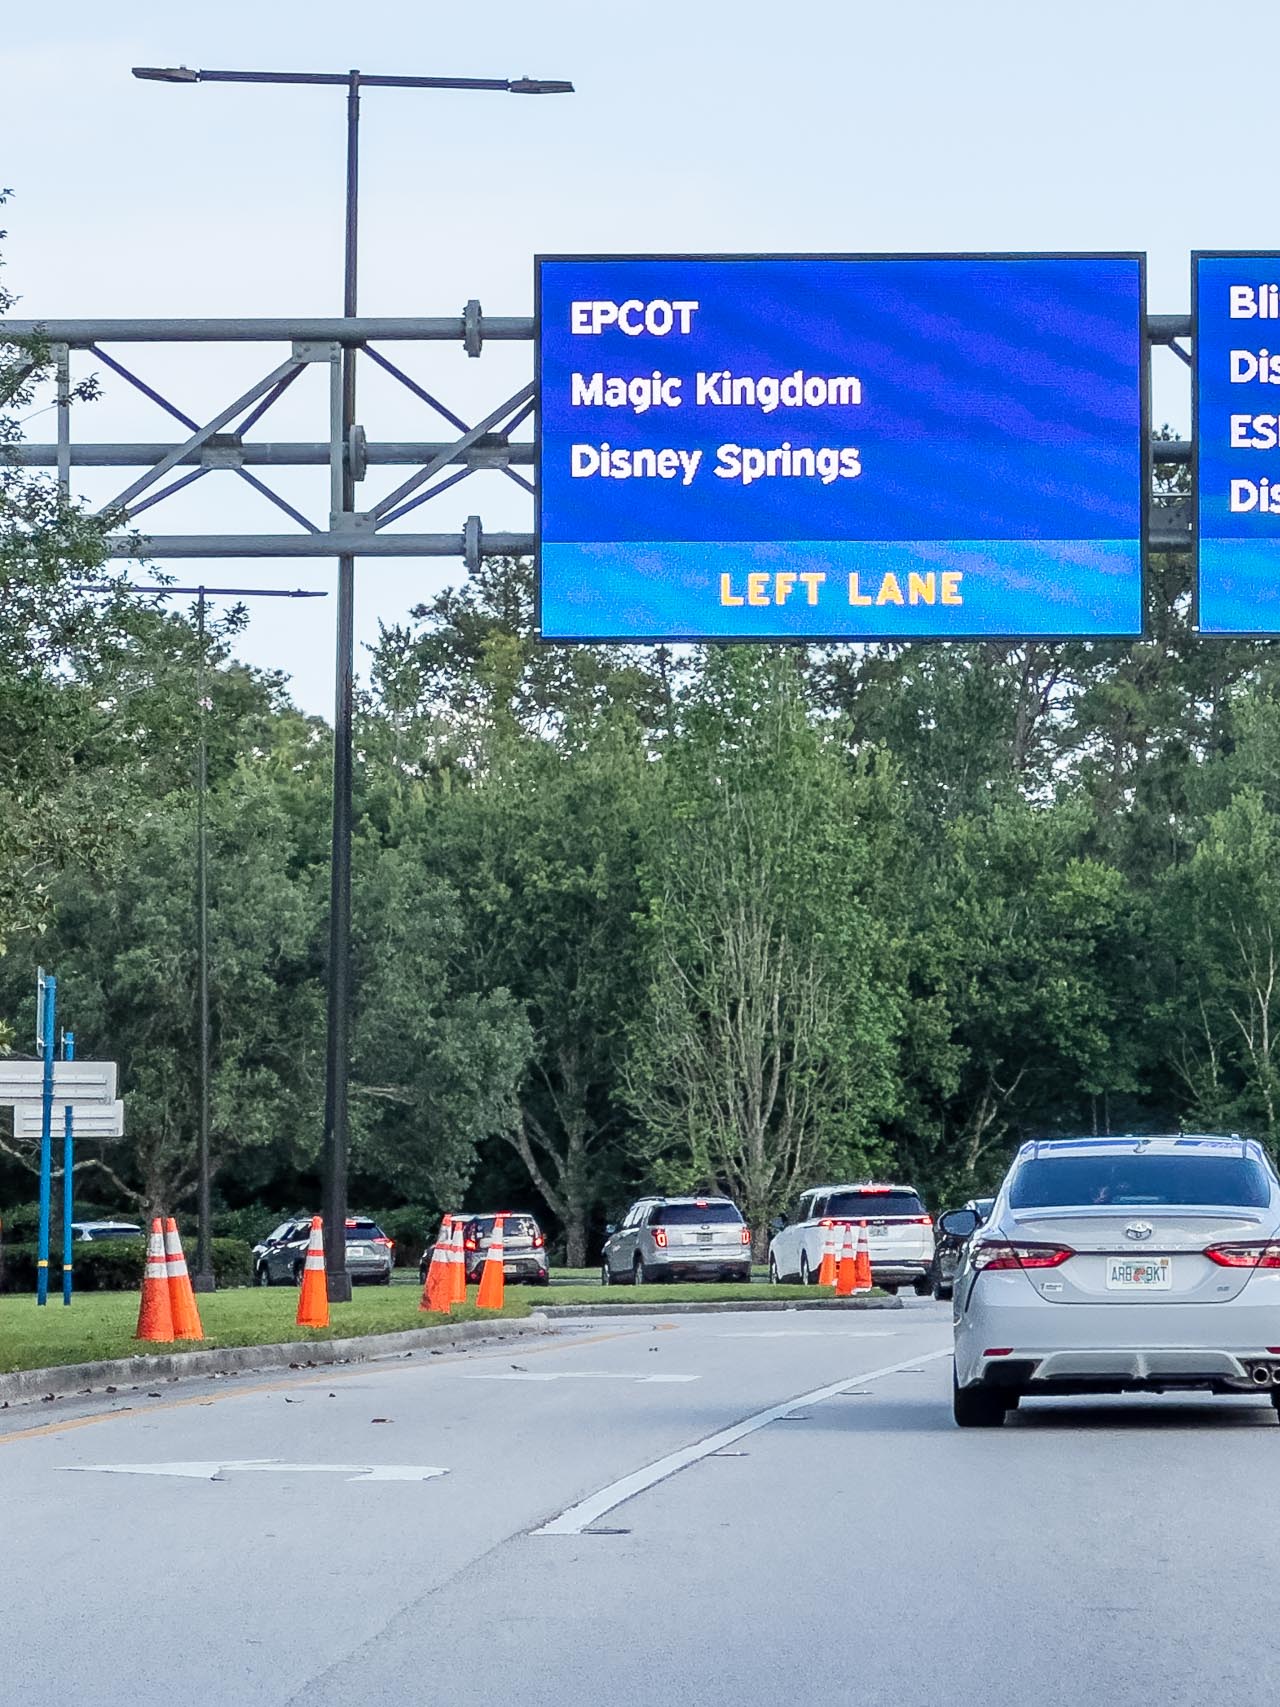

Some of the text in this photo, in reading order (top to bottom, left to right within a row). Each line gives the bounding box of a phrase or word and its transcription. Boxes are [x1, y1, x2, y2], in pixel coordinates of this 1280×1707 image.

[572, 300, 698, 335] EPCOT
[572, 370, 861, 413] Magic Kingdom
[572, 442, 861, 485] Disney Springs
[721, 571, 963, 606] LEFT LANE
